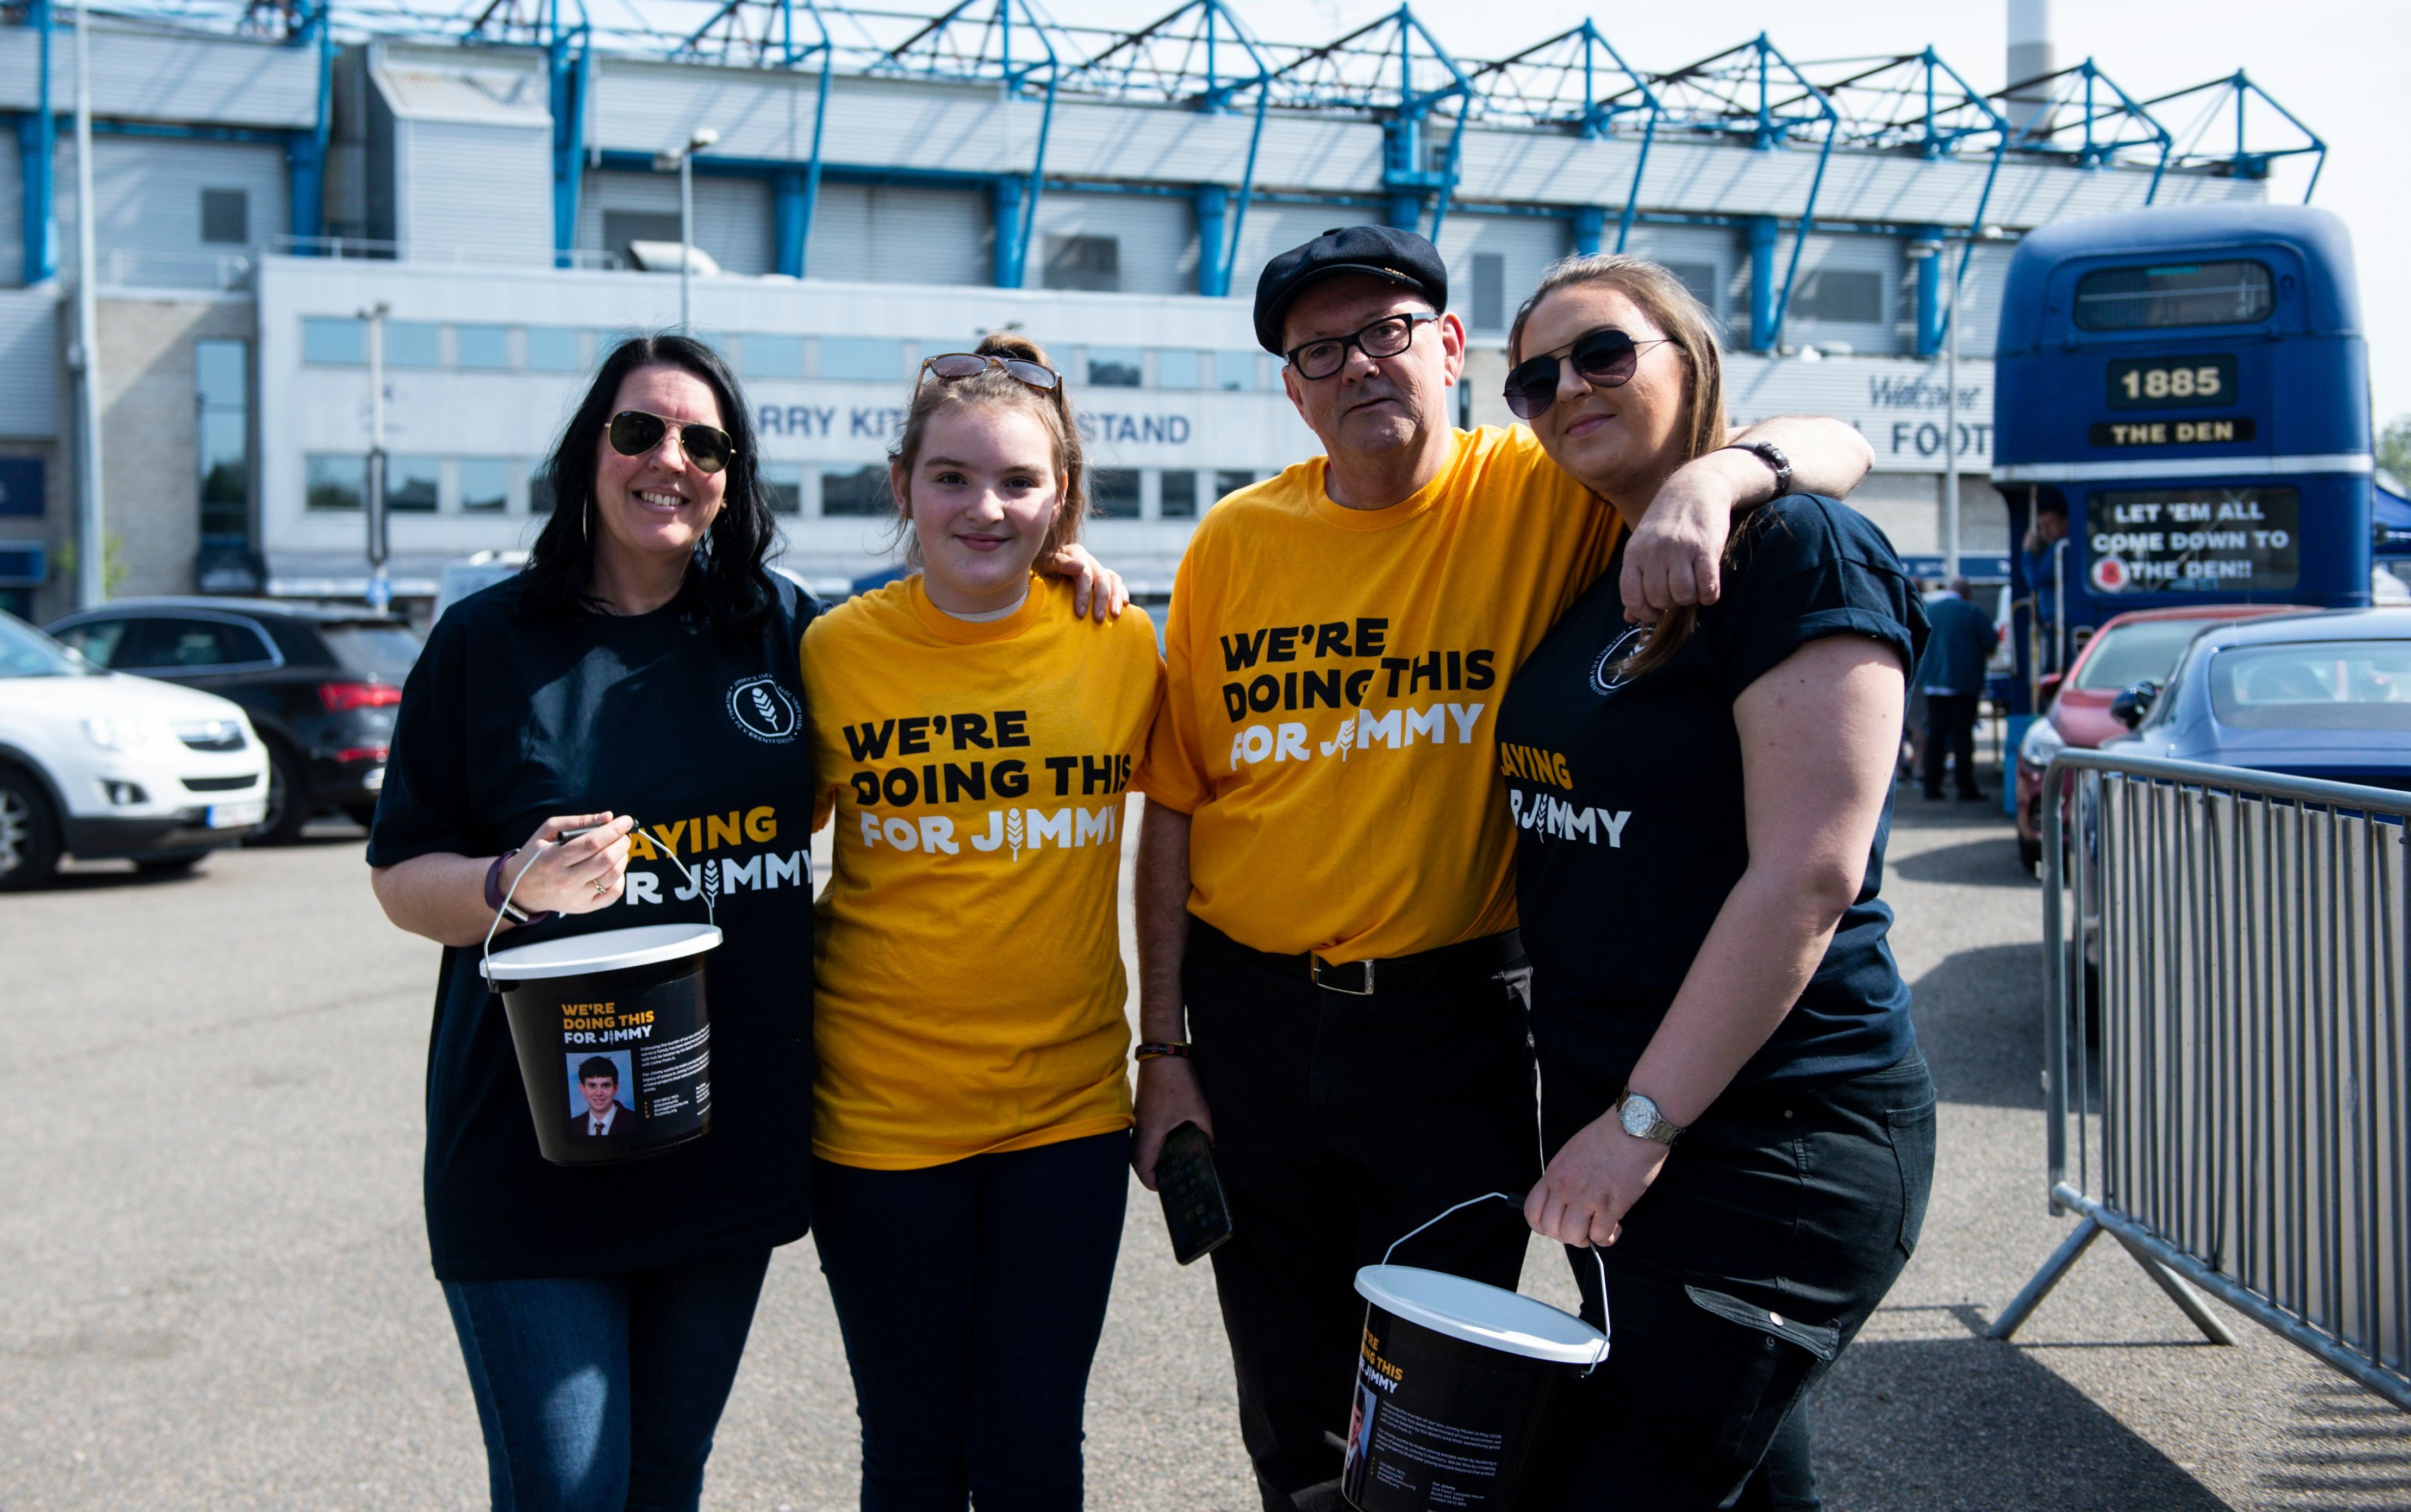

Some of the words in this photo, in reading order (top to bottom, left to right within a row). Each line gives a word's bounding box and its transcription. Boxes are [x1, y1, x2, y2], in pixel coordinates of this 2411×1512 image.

[2121, 366, 2221, 399] 1885
[760, 404, 835, 436] RRY
[1077, 411, 1190, 446] STAND
[2111, 424, 2167, 445] THE
[2176, 420, 2234, 442] DEN
[1892, 422, 1993, 455] FOOT
[2114, 504, 2160, 523] LET
[2167, 503, 2212, 522] 'EM
[2217, 501, 2265, 521] ALL
[2092, 533, 2164, 553] COME
[2170, 531, 2247, 551] DOWN
[2253, 530, 2289, 549] TO
[2128, 561, 2176, 580] THE
[2184, 559, 2252, 579] DEN!!
[1220, 617, 1388, 672] WE'RE
[1223, 669, 1375, 723] DOING
[1381, 649, 1495, 698] THIS
[734, 720, 743, 729] FC
[842, 710, 1031, 762] WE'RE
[1230, 722, 1310, 772] FOR
[1319, 703, 1485, 762] JIMMY
[851, 759, 1029, 807] DOING
[1045, 754, 1131, 796] THIS
[1500, 742, 1573, 790] AYING
[627, 805, 777, 864] AYING
[860, 810, 960, 855] FOR
[1521, 792, 1632, 848] JIMMY
[562, 1002, 615, 1016] WE'RE
[563, 1016, 615, 1030] DOING
[618, 1010, 655, 1027] THIS
[564, 1032, 596, 1044] FOR
[599, 1024, 652, 1046] JIMMY
[1376, 1356, 1403, 1381] THIS
